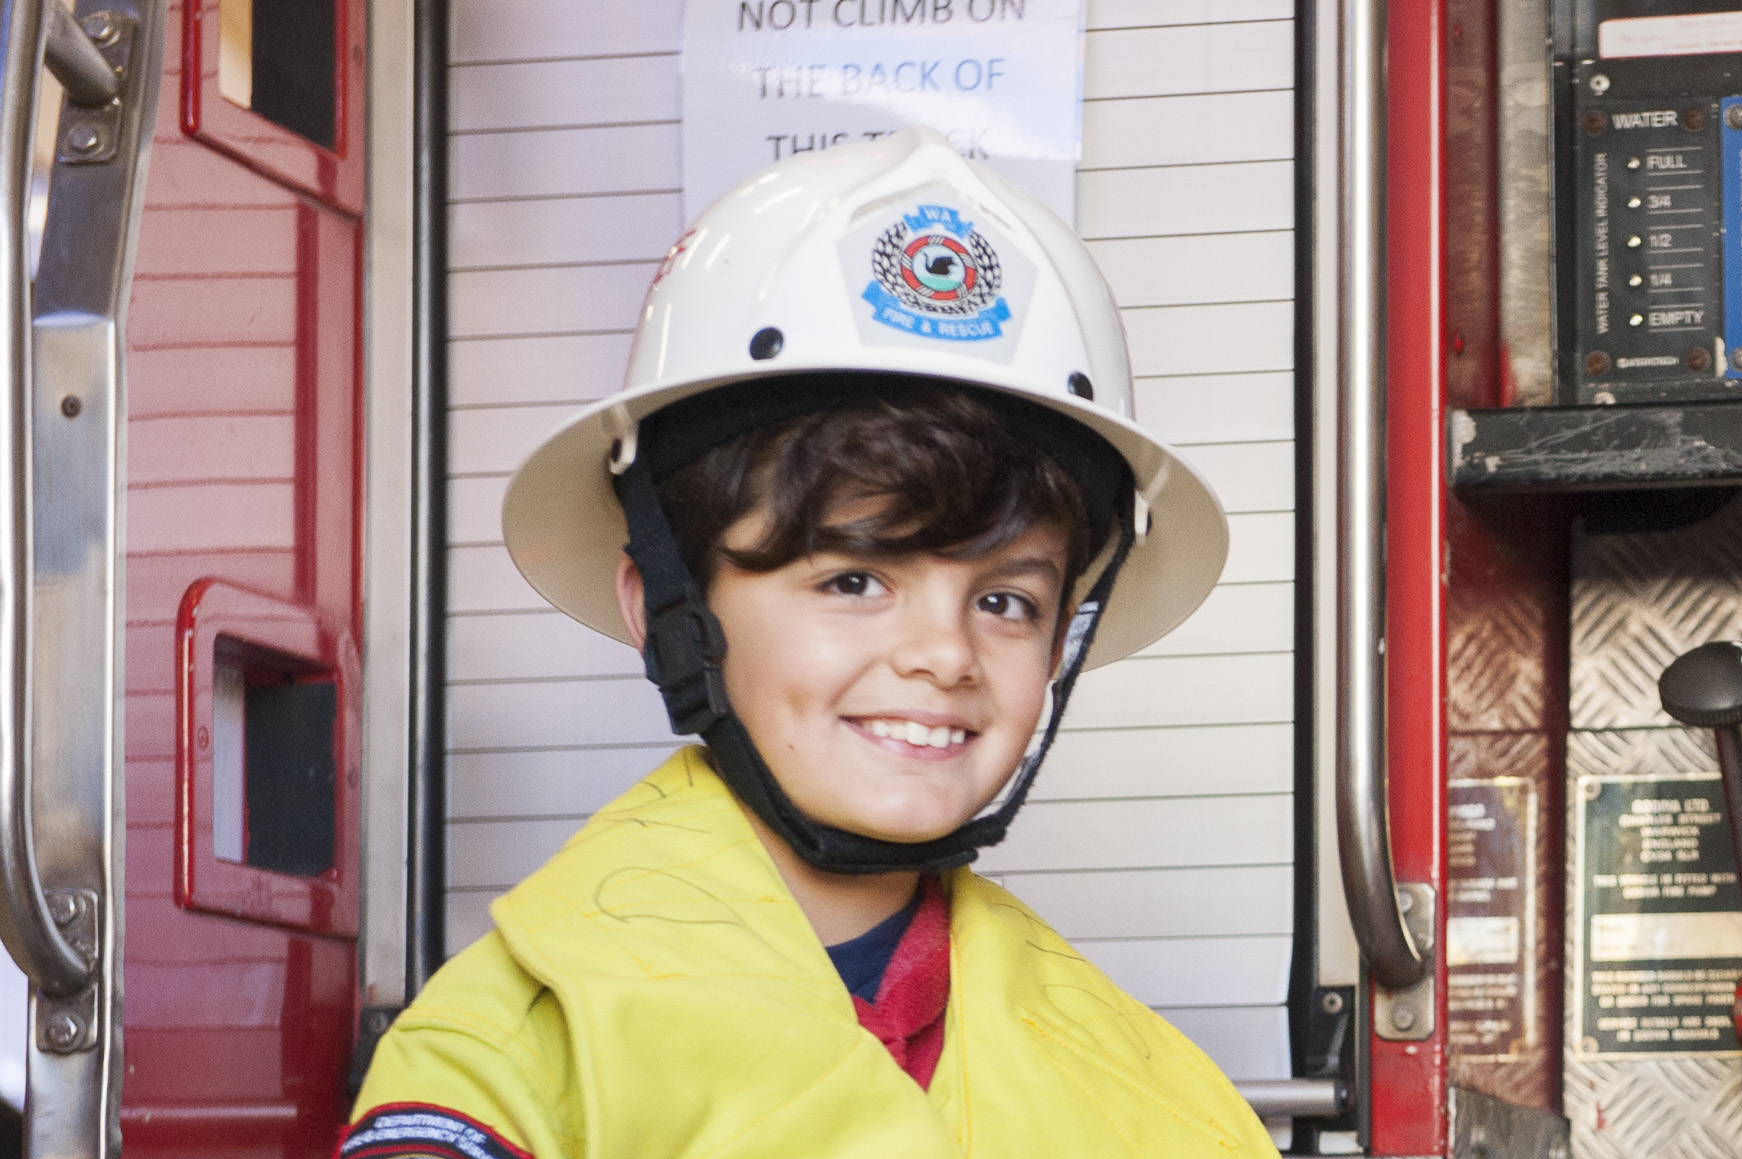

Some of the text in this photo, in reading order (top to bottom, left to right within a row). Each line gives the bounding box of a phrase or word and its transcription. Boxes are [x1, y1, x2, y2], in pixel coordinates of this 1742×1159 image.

[737, 0, 1026, 32] NOT CLIMB ON
[754, 57, 1006, 99] THE BACK OF
[1612, 110, 1678, 130] WATER
[1646, 154, 1688, 169] FULL
[1647, 194, 1672, 209] 3/4
[923, 207, 952, 223] WA
[1649, 233, 1673, 248] 1/2
[1649, 272, 1673, 287] 1/4
[881, 306, 996, 338] FIRE & RESCUE
[1648, 310, 1705, 326] EMPTY
